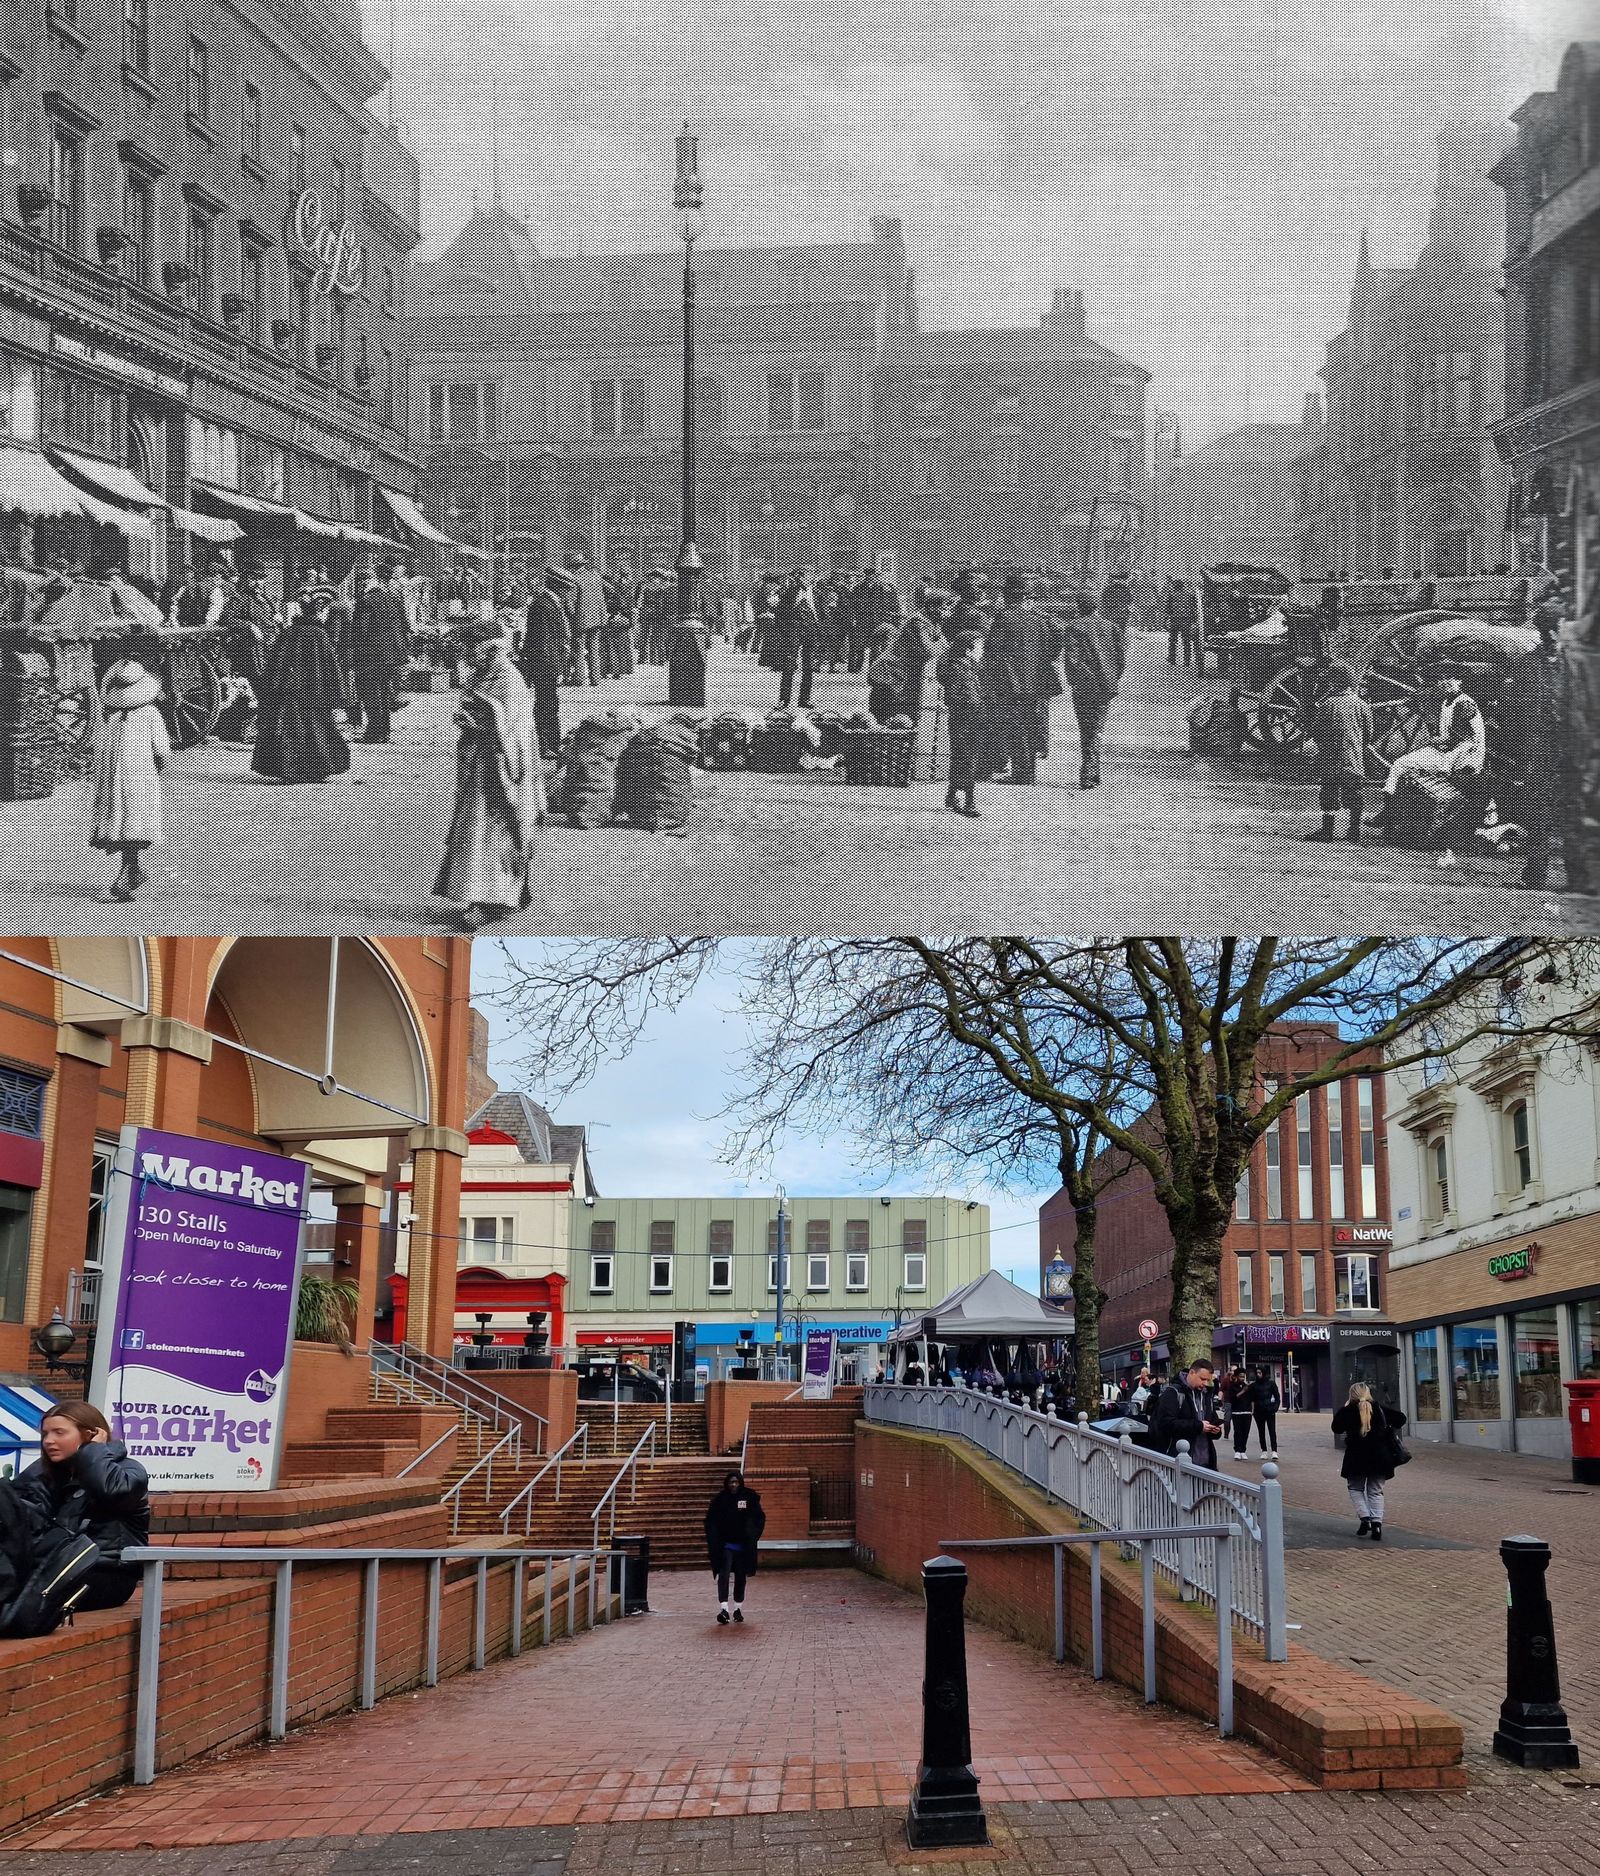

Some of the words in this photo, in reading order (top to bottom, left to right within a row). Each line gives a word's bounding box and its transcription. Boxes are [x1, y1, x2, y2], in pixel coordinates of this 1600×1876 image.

[140, 1152, 299, 1210] Market
[138, 1205, 172, 1225] 130
[177, 1210, 228, 1233] Stalls
[1353, 1228, 1392, 1240] NatWe
[134, 1227, 169, 1241] Open
[173, 1232, 220, 1250] Monday
[223, 1239, 234, 1250] to
[237, 1241, 282, 1260] Saturday
[172, 1272, 224, 1287] closer
[230, 1276, 247, 1288] to
[252, 1278, 288, 1291] home
[1340, 1329, 1392, 1337] DEFIBRILLATOR
[145, 1342, 245, 1358] stokeontrentmarkets
[112, 1402, 157, 1414] YOUR
[162, 1404, 210, 1416] LOCAL
[111, 1410, 272, 1453] market
[130, 1445, 196, 1457] HANLEY
[147, 1472, 214, 1480] ov.uk/markets
[237, 1467, 255, 1475] stoke
